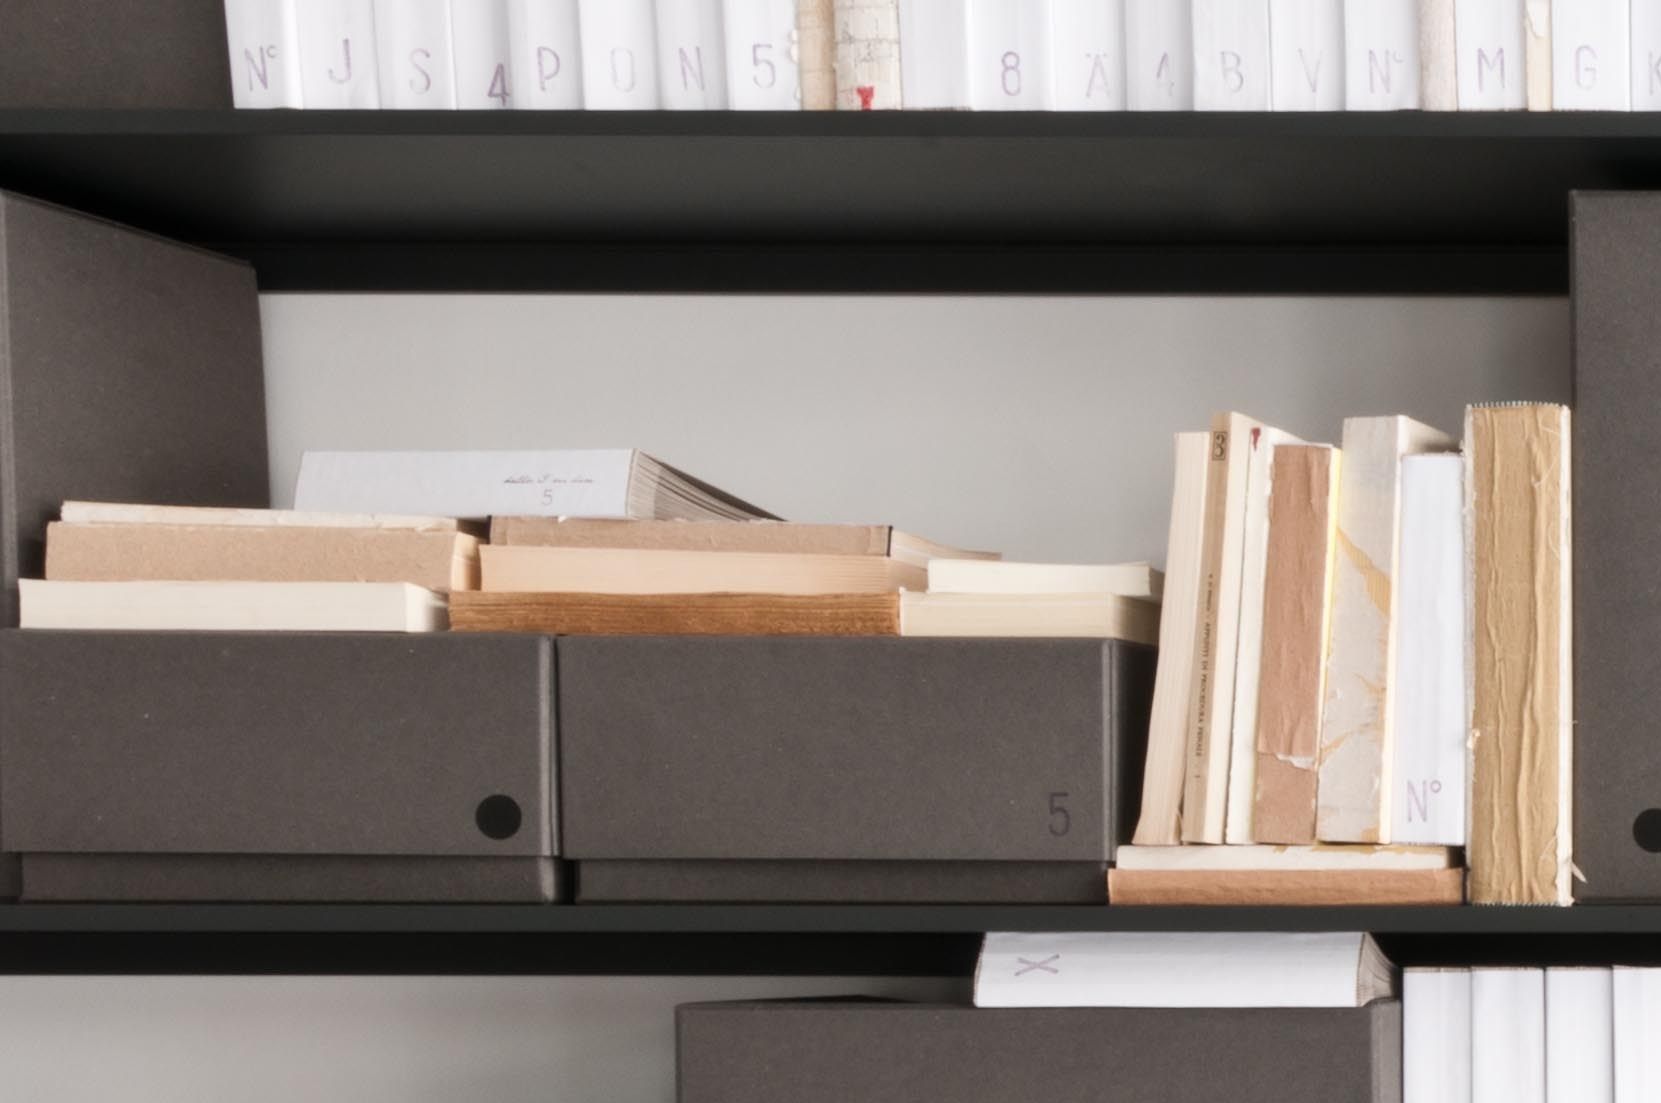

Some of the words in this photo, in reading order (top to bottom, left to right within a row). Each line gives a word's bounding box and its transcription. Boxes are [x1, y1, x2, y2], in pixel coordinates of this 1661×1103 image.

[327, 37, 353, 85] J
[408, 47, 432, 96] S
[537, 46, 561, 93] P
[677, 45, 706, 92] N
[751, 42, 777, 89] 5
[1000, 50, 1021, 97] 8
[1219, 50, 1245, 94] B
[1476, 46, 1506, 93] M
[1573, 44, 1600, 92] G
[541, 487, 554, 507] 5
[1048, 791, 1072, 838] 5
